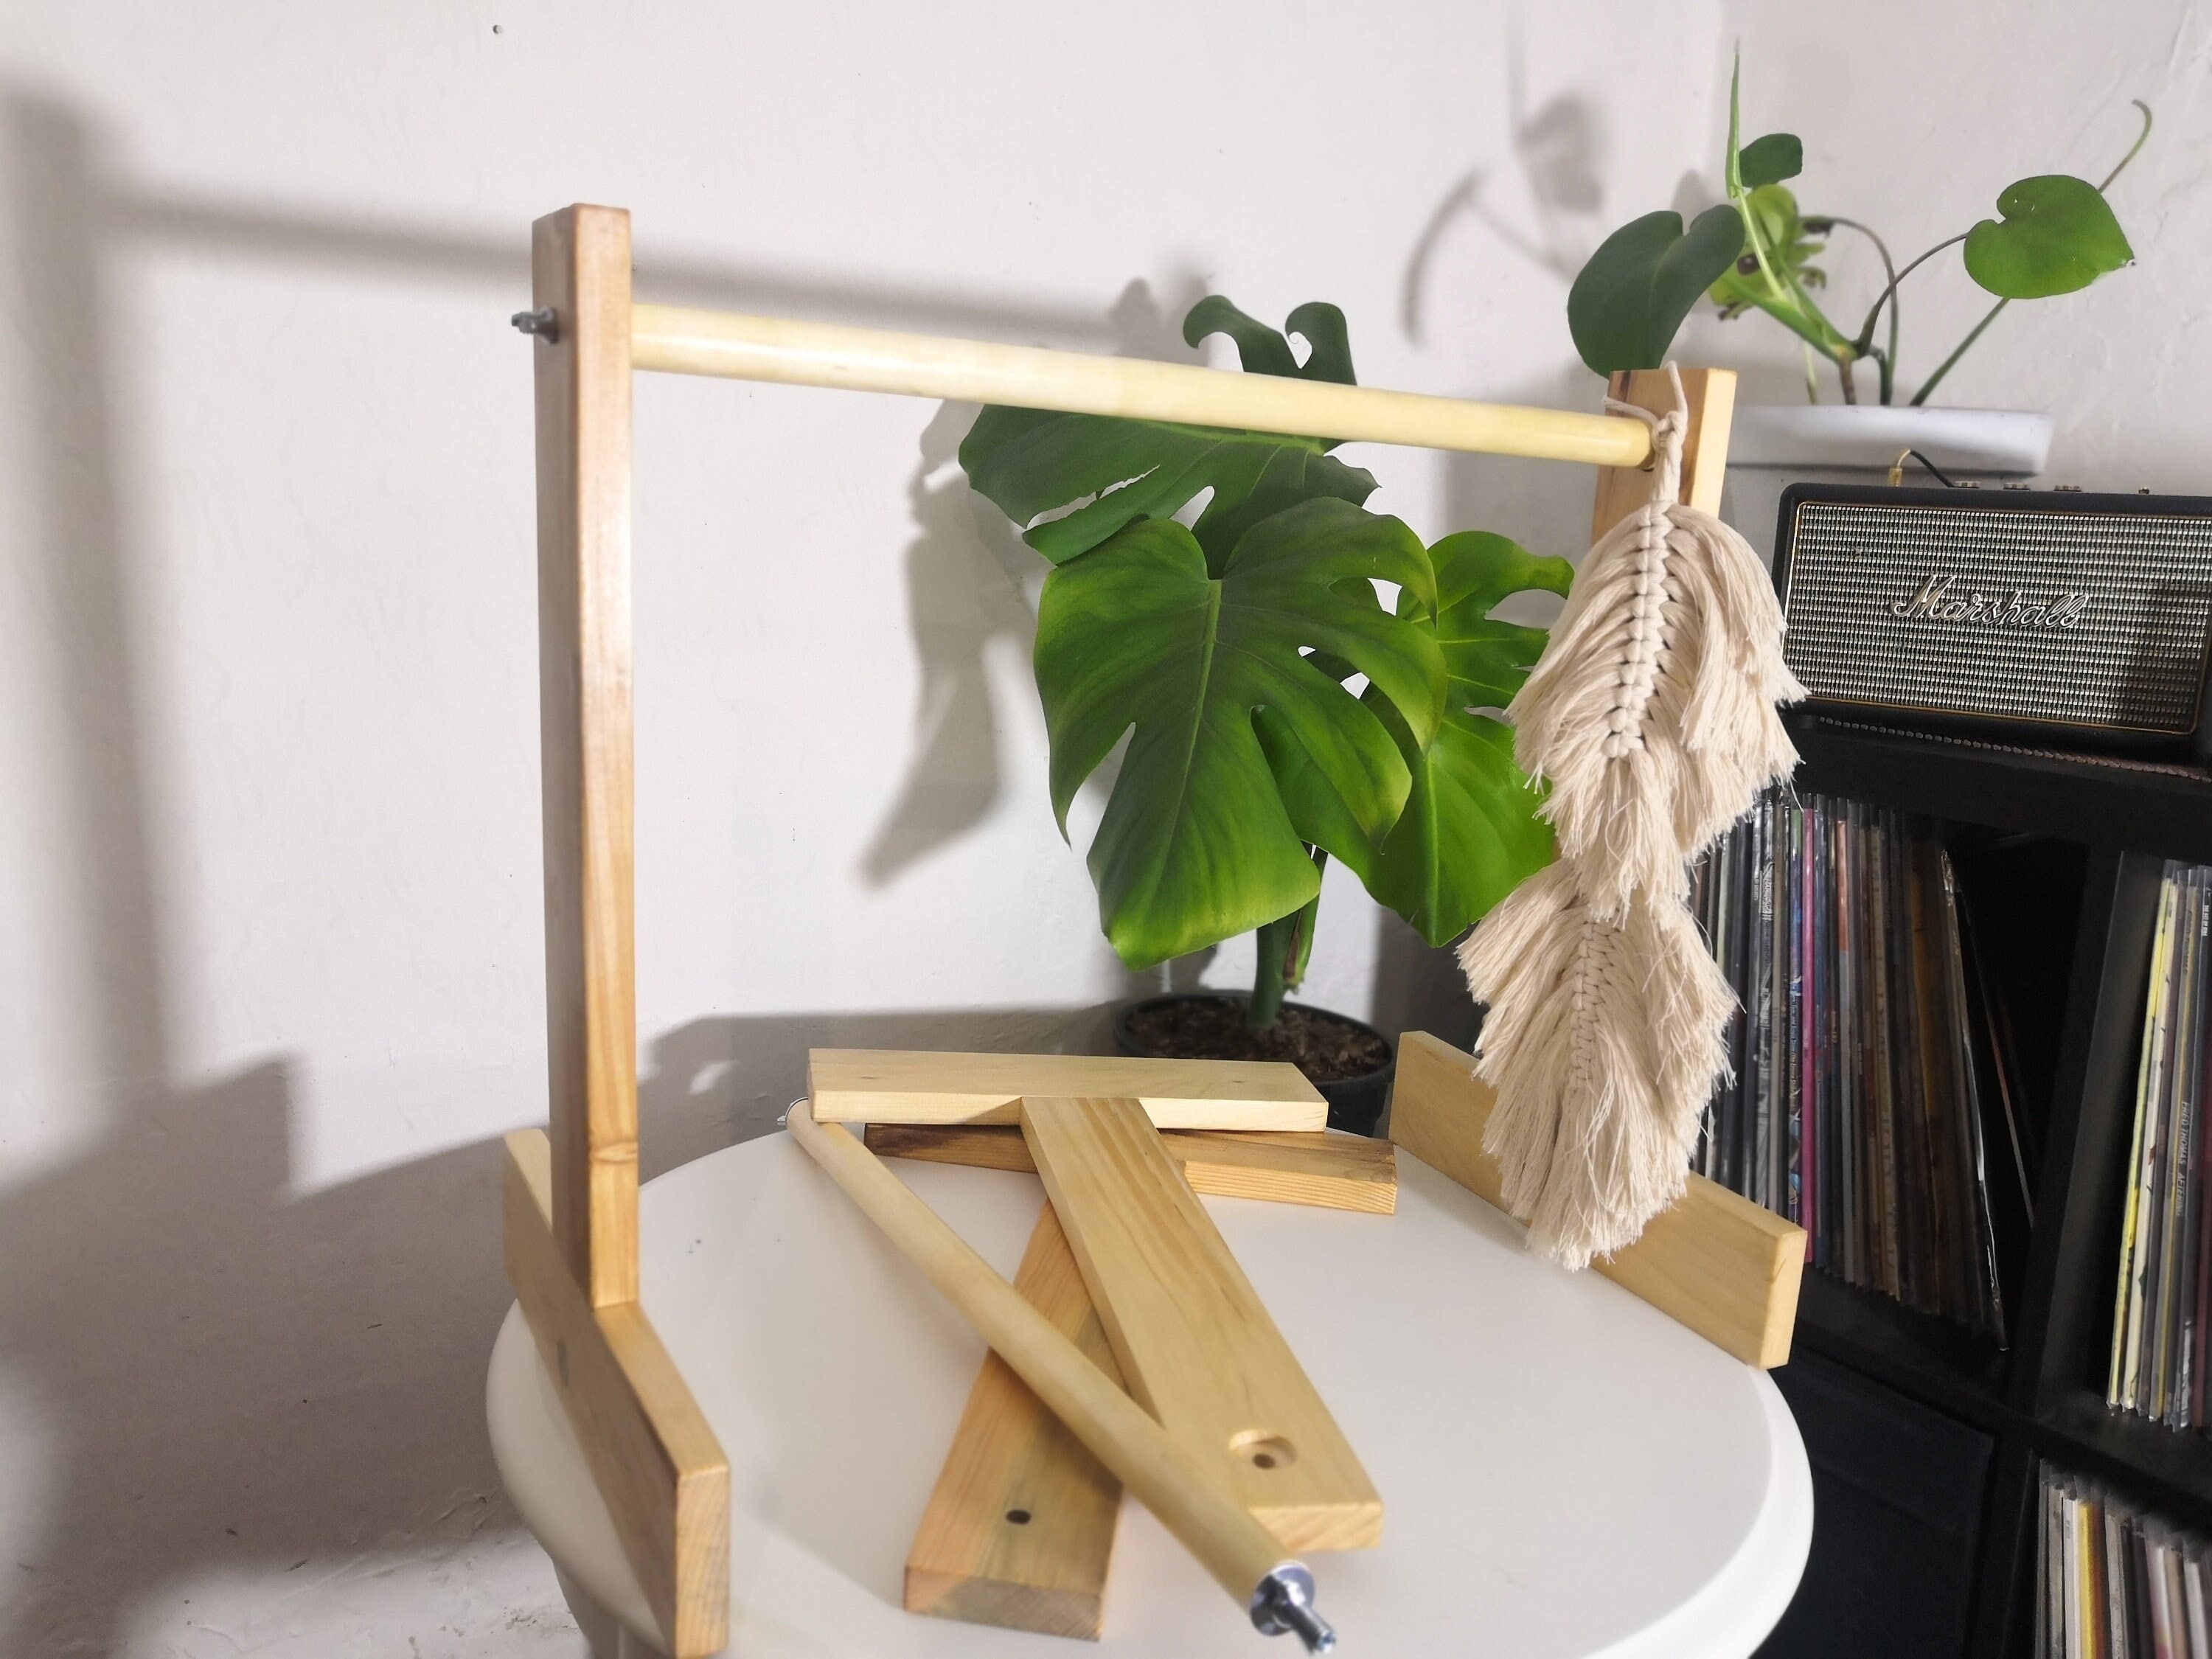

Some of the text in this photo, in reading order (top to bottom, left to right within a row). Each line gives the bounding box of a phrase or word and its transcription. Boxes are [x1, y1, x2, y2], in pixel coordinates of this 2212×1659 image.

[1892, 574, 2089, 627] Marshall
[2181, 1100, 2190, 1126] FRED
[2179, 1127, 2188, 1165] THOMAS
